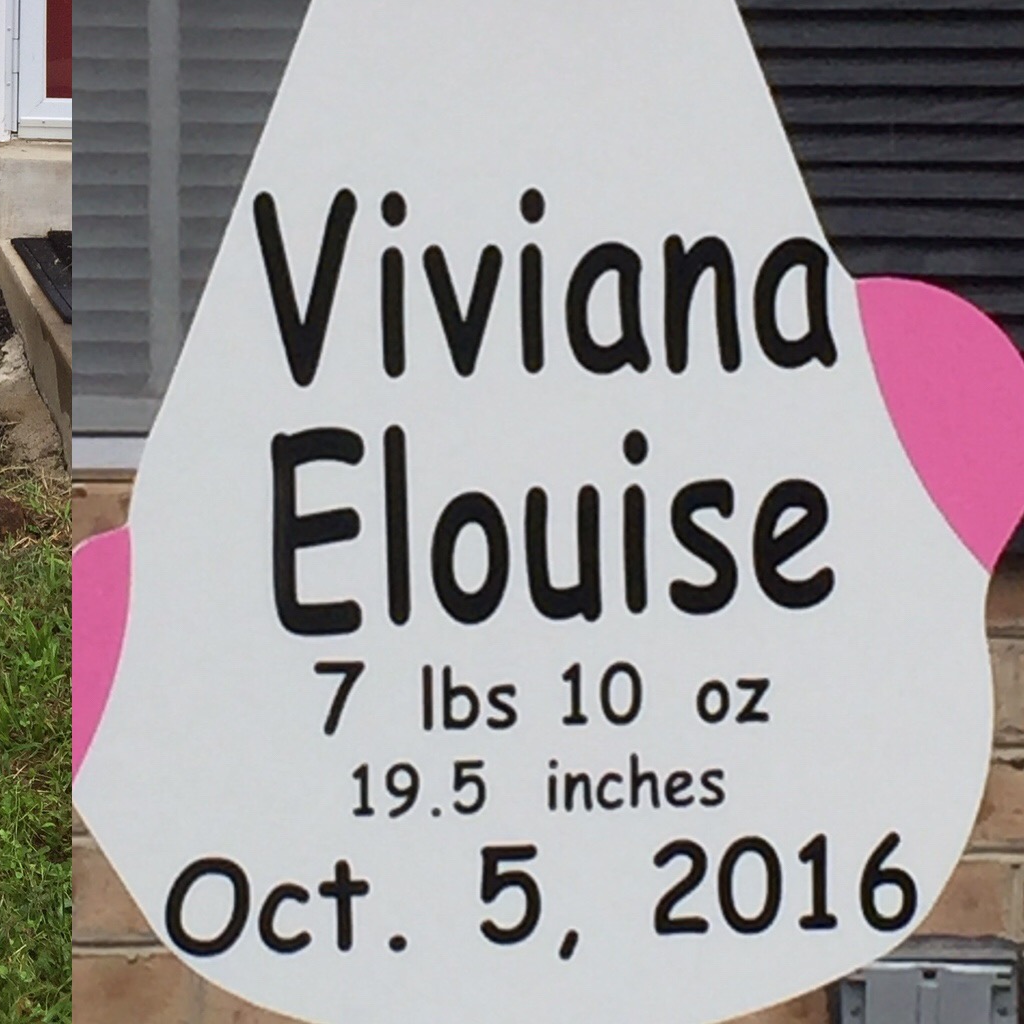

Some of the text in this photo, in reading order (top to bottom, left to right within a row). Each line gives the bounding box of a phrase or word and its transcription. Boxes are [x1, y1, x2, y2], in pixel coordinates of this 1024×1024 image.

[252, 187, 838, 388] Viviana
[270, 424, 835, 637] Elouise
[313, 661, 770, 736] 7 lbs 10 oz
[352, 753, 725, 818] 19.5 inches
[164, 832, 919, 960] Oct. 5, 2016
